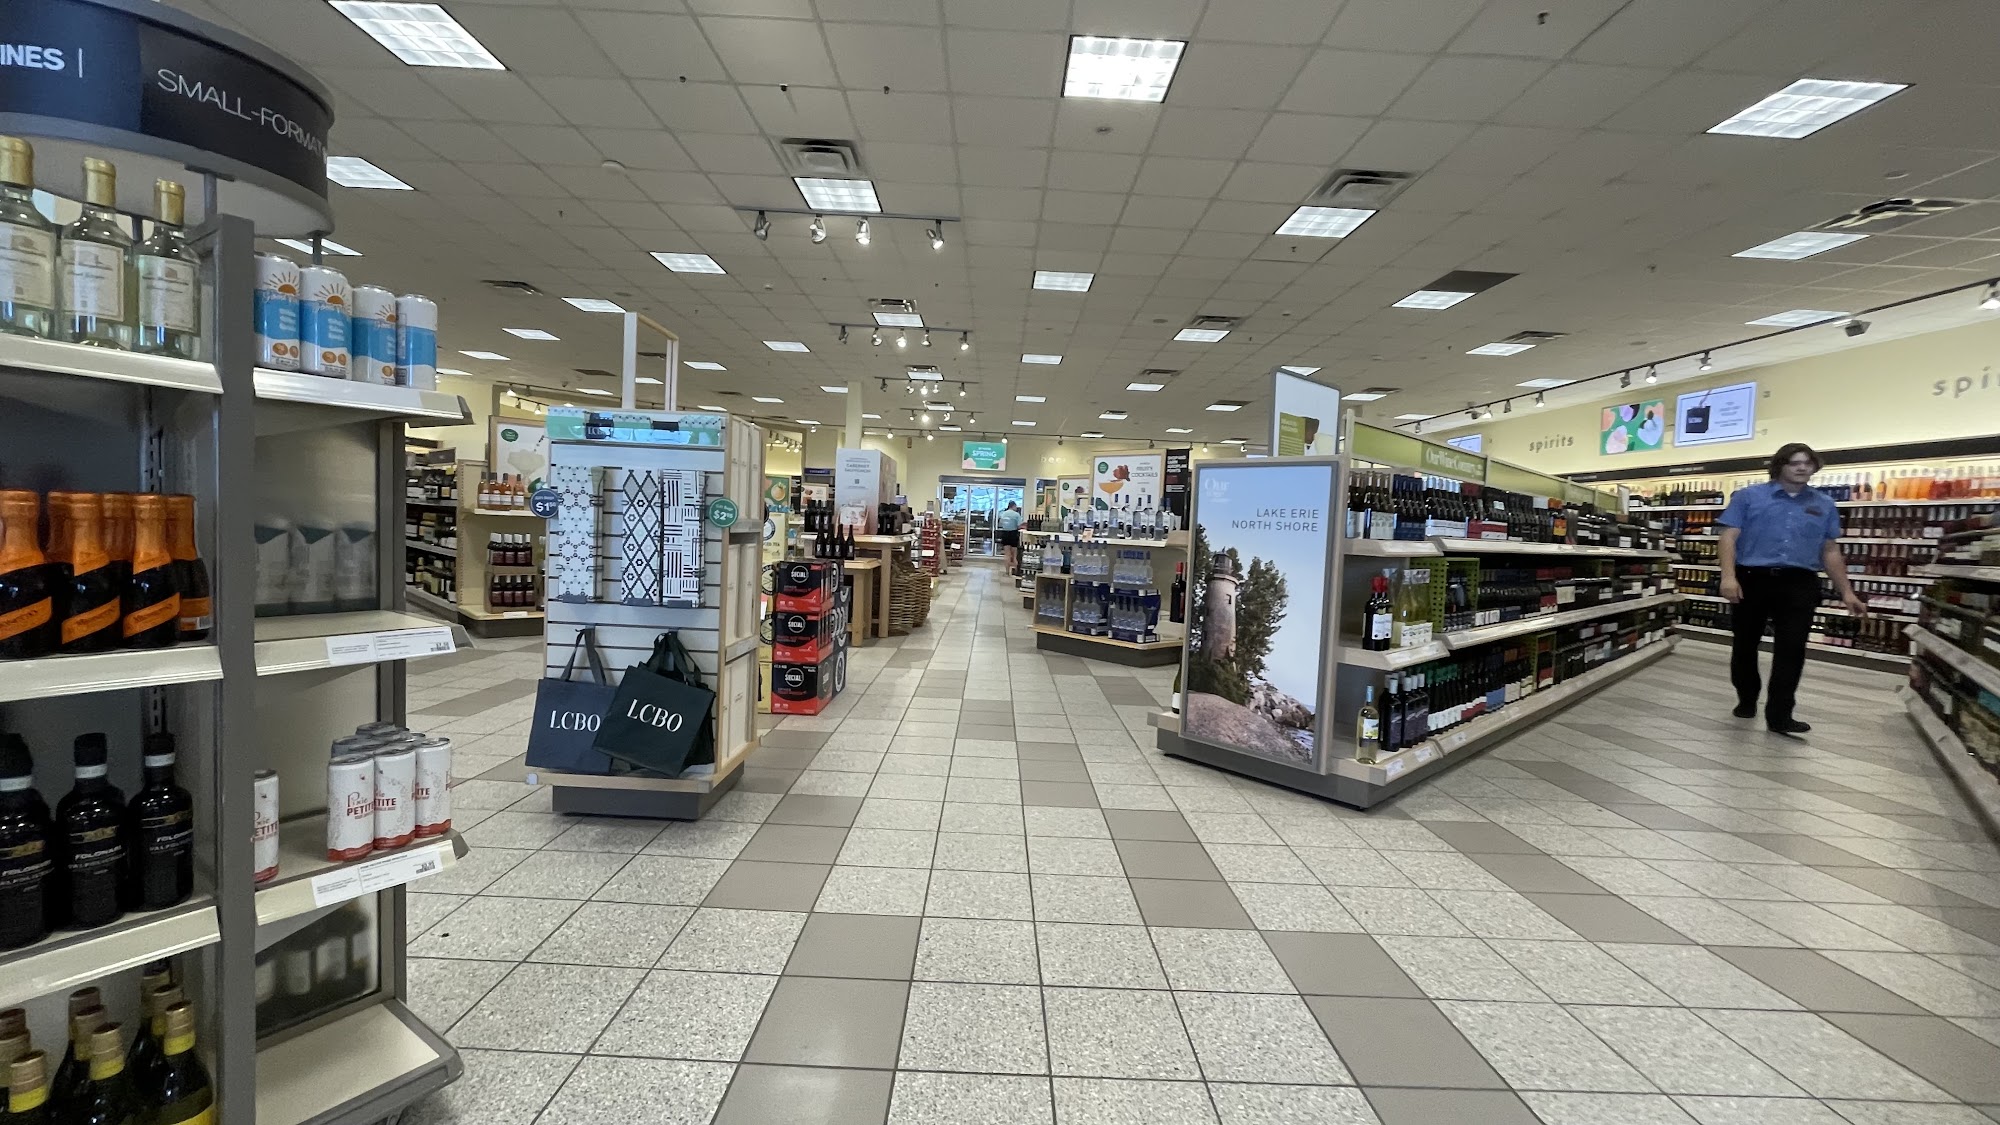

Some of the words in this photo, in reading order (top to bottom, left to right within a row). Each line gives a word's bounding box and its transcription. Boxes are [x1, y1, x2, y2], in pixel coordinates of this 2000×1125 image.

[1931, 365, 2000, 399] spi
[972, 450, 997, 458] SPRING
[1529, 434, 1574, 454] spirits
[1256, 508, 1287, 519] LAKE
[1291, 509, 1320, 519] ERIE
[1232, 520, 1272, 530] NORTH
[1275, 521, 1319, 532] SHORE
[549, 710, 601, 732] LCBO
[626, 698, 683, 733] LCBO
